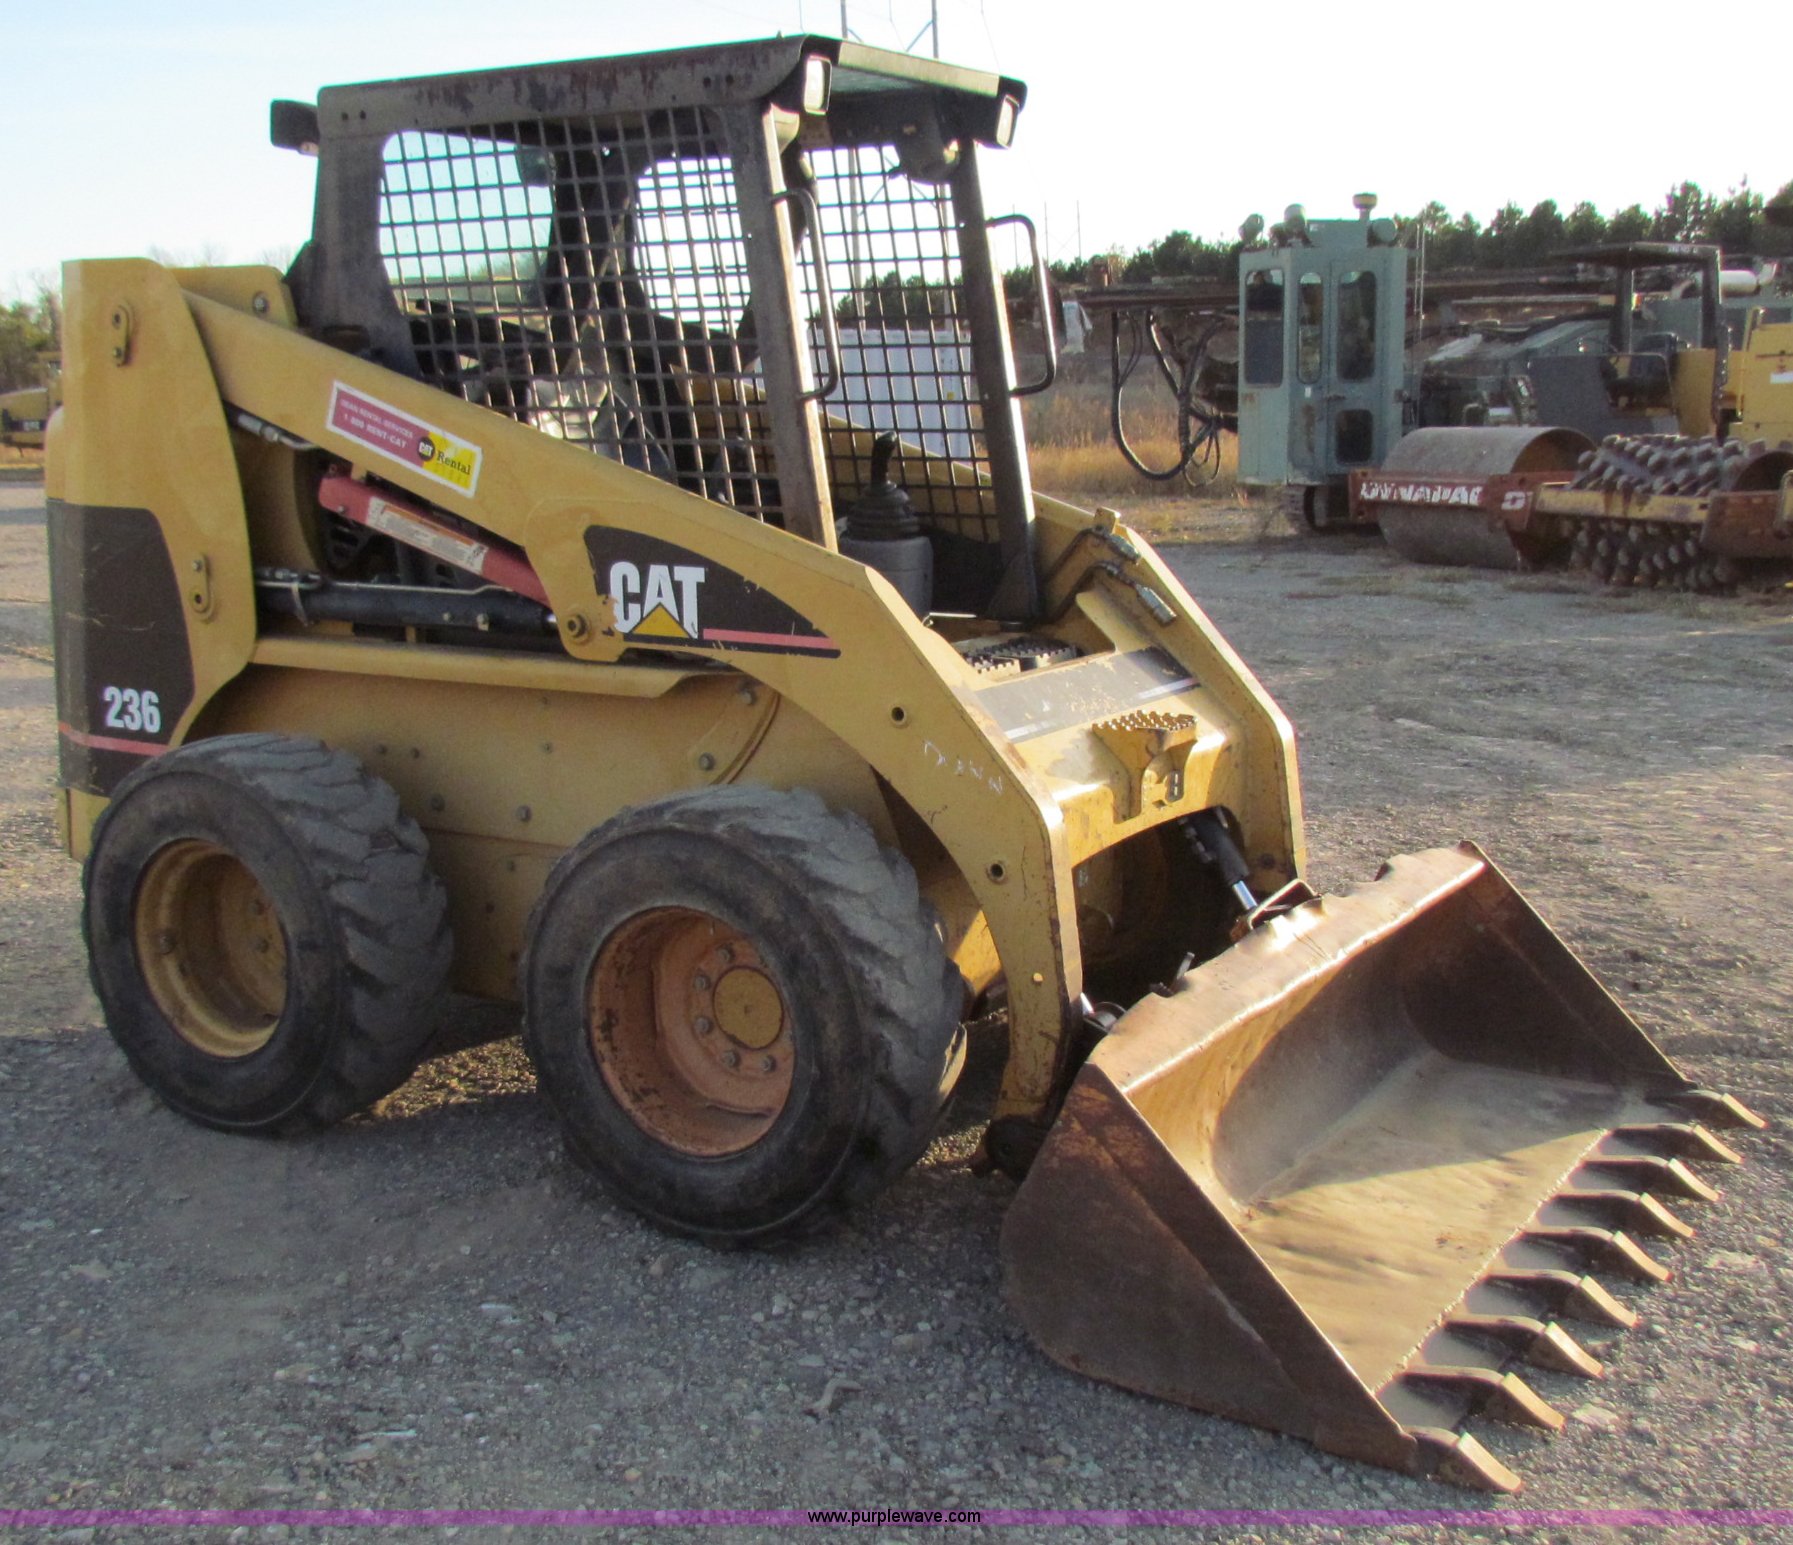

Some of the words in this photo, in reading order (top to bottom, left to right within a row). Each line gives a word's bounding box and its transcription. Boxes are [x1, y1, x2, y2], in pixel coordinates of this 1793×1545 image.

[418, 441, 434, 457] CAT
[436, 449, 471, 475] Rental
[609, 561, 706, 639] CAT
[103, 686, 161, 733] 236
